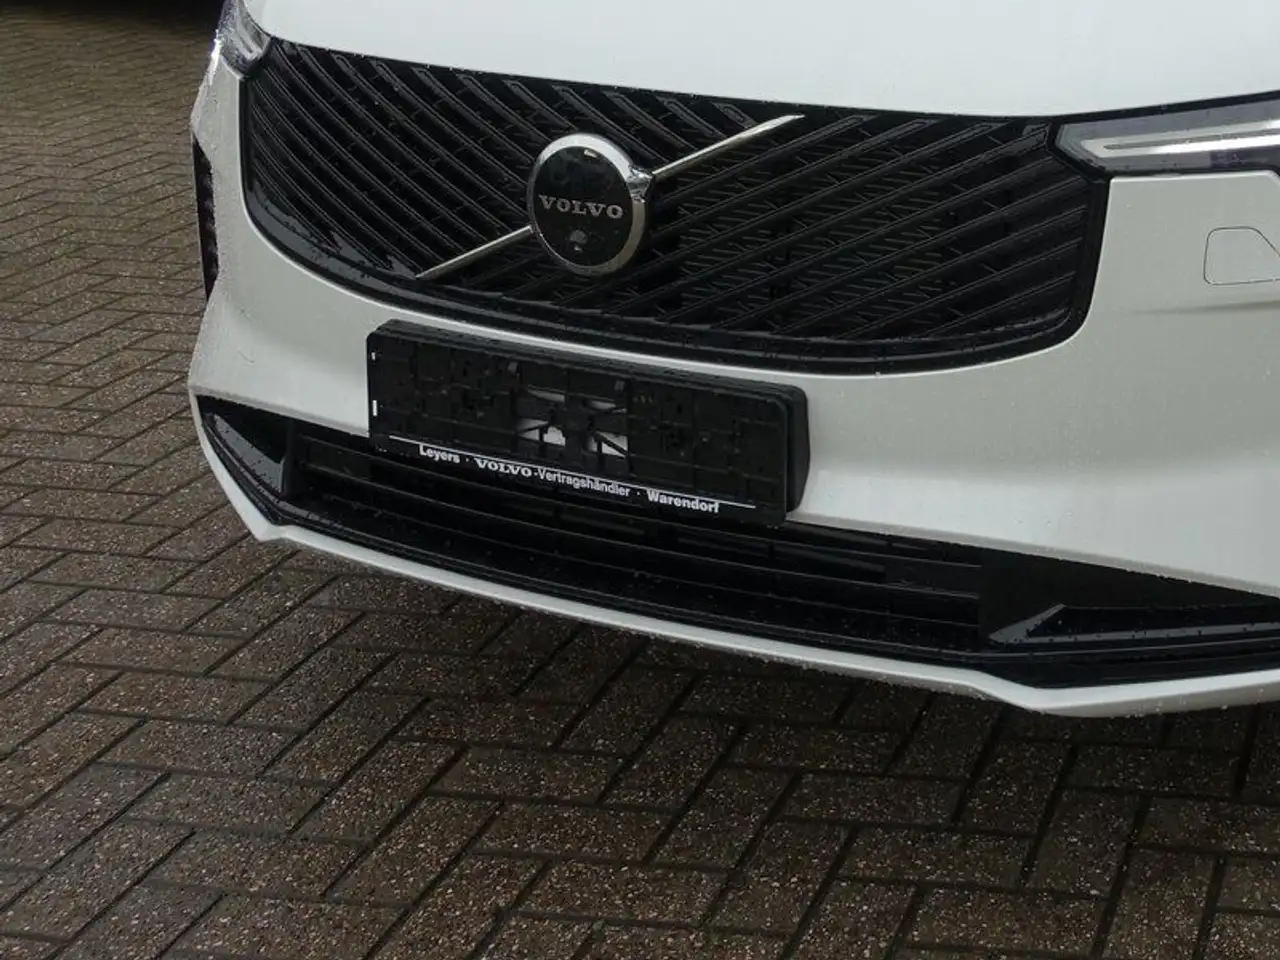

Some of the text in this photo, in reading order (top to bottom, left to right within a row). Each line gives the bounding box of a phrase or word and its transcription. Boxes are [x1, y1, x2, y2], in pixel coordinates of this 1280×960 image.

[538, 194, 624, 219] VOLVO
[418, 443, 460, 464] Leyers
[646, 489, 720, 514] Warendorf
